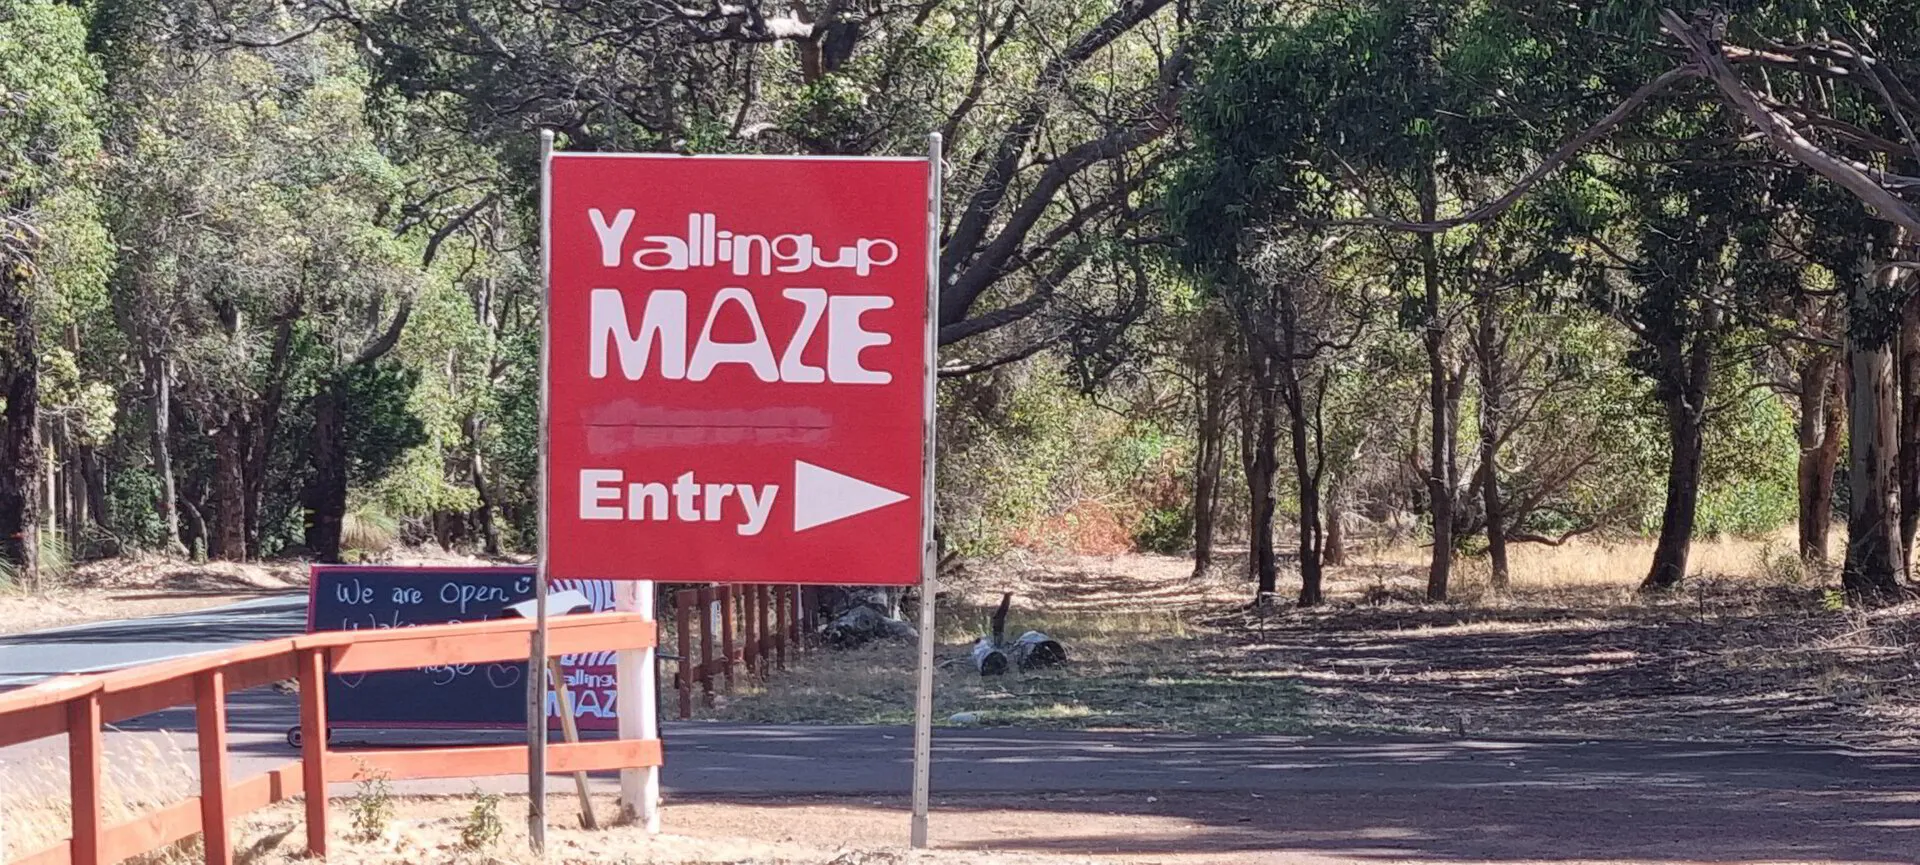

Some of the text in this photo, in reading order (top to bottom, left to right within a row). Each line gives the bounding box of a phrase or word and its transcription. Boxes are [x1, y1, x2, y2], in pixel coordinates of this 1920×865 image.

[588, 208, 898, 277] Yallingup
[589, 287, 895, 385] MAZE
[579, 468, 779, 536] Entry
[336, 578, 374, 605] We
[392, 587, 424, 604] are
[546, 689, 618, 718] MAZ
